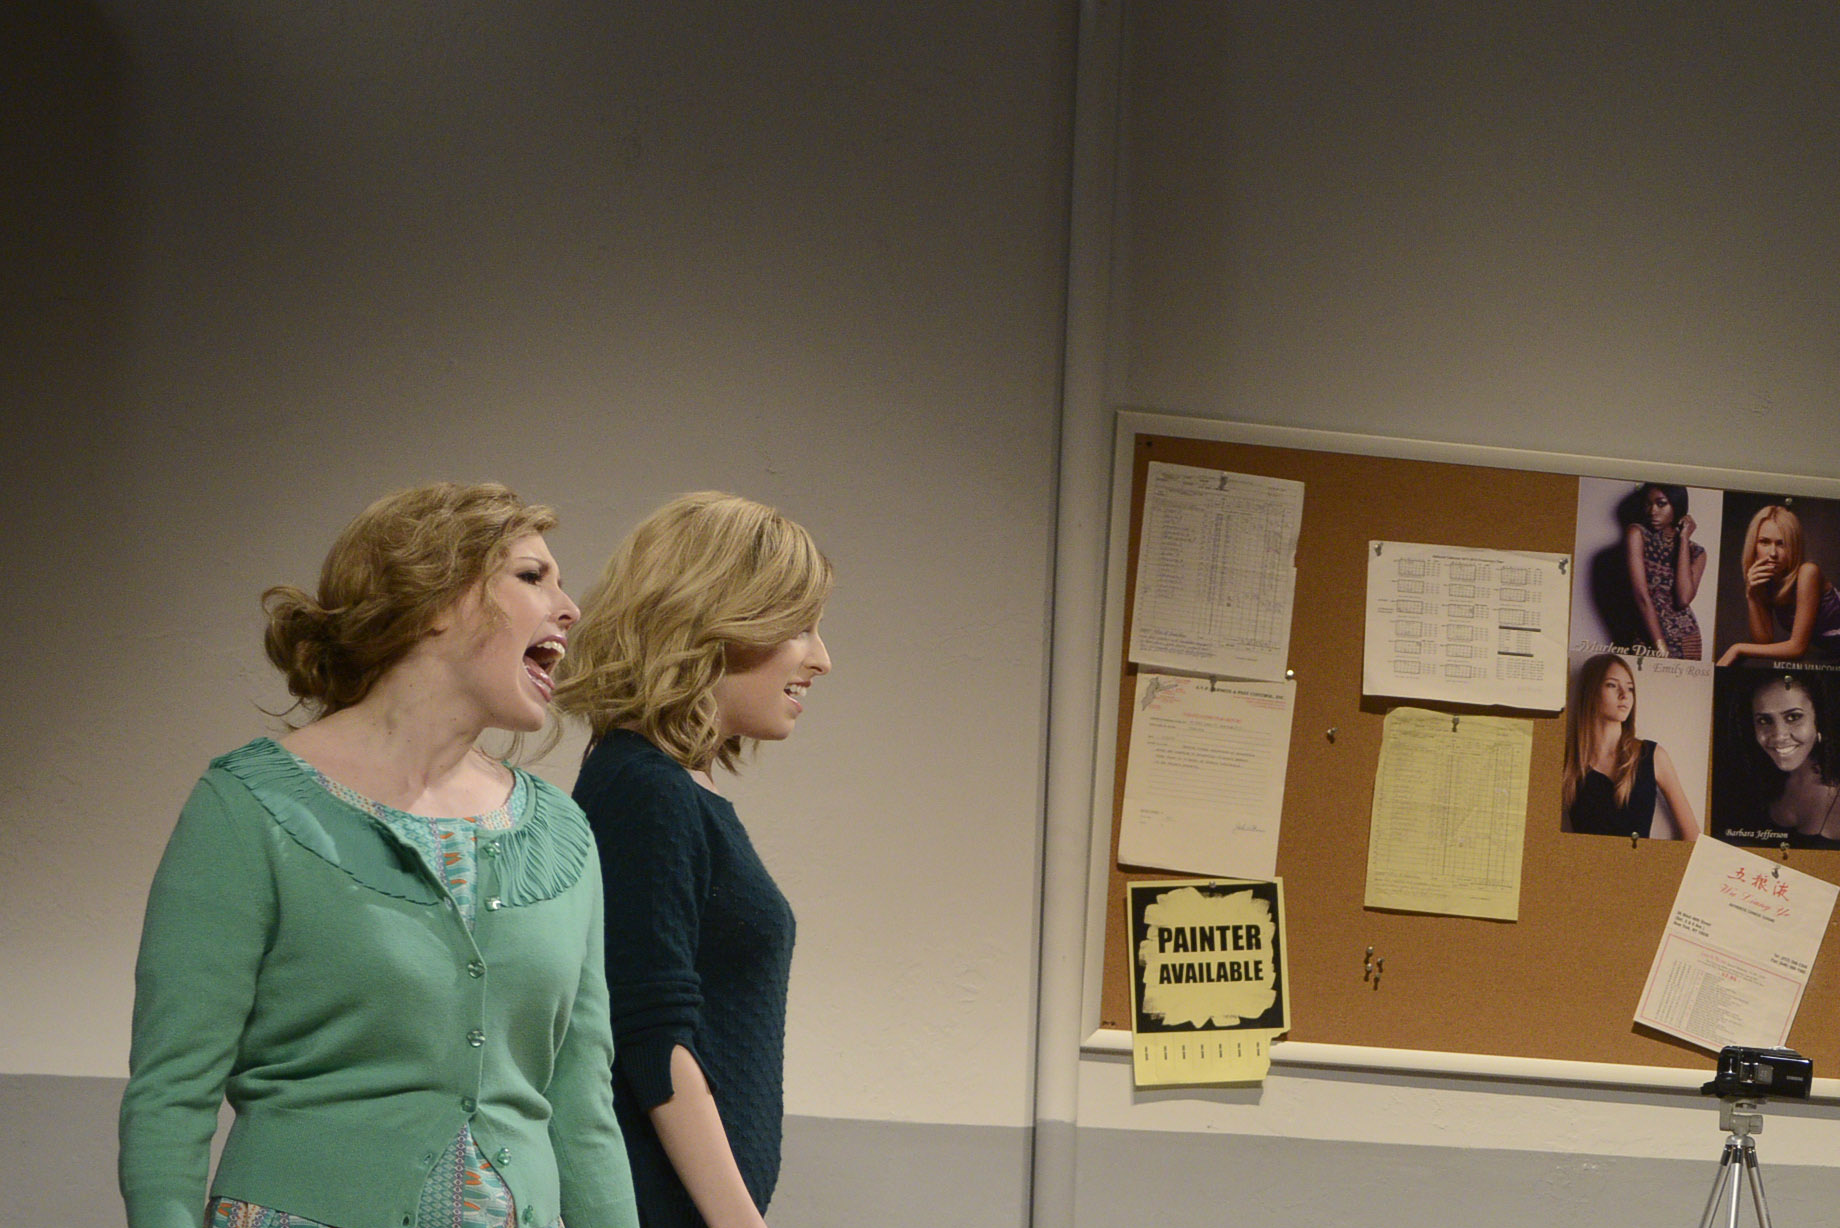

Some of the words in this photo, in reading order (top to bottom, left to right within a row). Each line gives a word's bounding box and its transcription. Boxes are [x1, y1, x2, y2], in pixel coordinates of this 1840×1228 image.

[1575, 640, 1630, 655] Marlene
[1631, 644, 1669, 658] Dixon
[1653, 662, 1683, 677] Emily
[1687, 665, 1710, 677] Ross
[1726, 829, 1754, 837] Barbara
[1755, 829, 1788, 840] Jefferson
[1158, 924, 1262, 954] PAINTER
[1159, 960, 1264, 985] AVAILABLE
